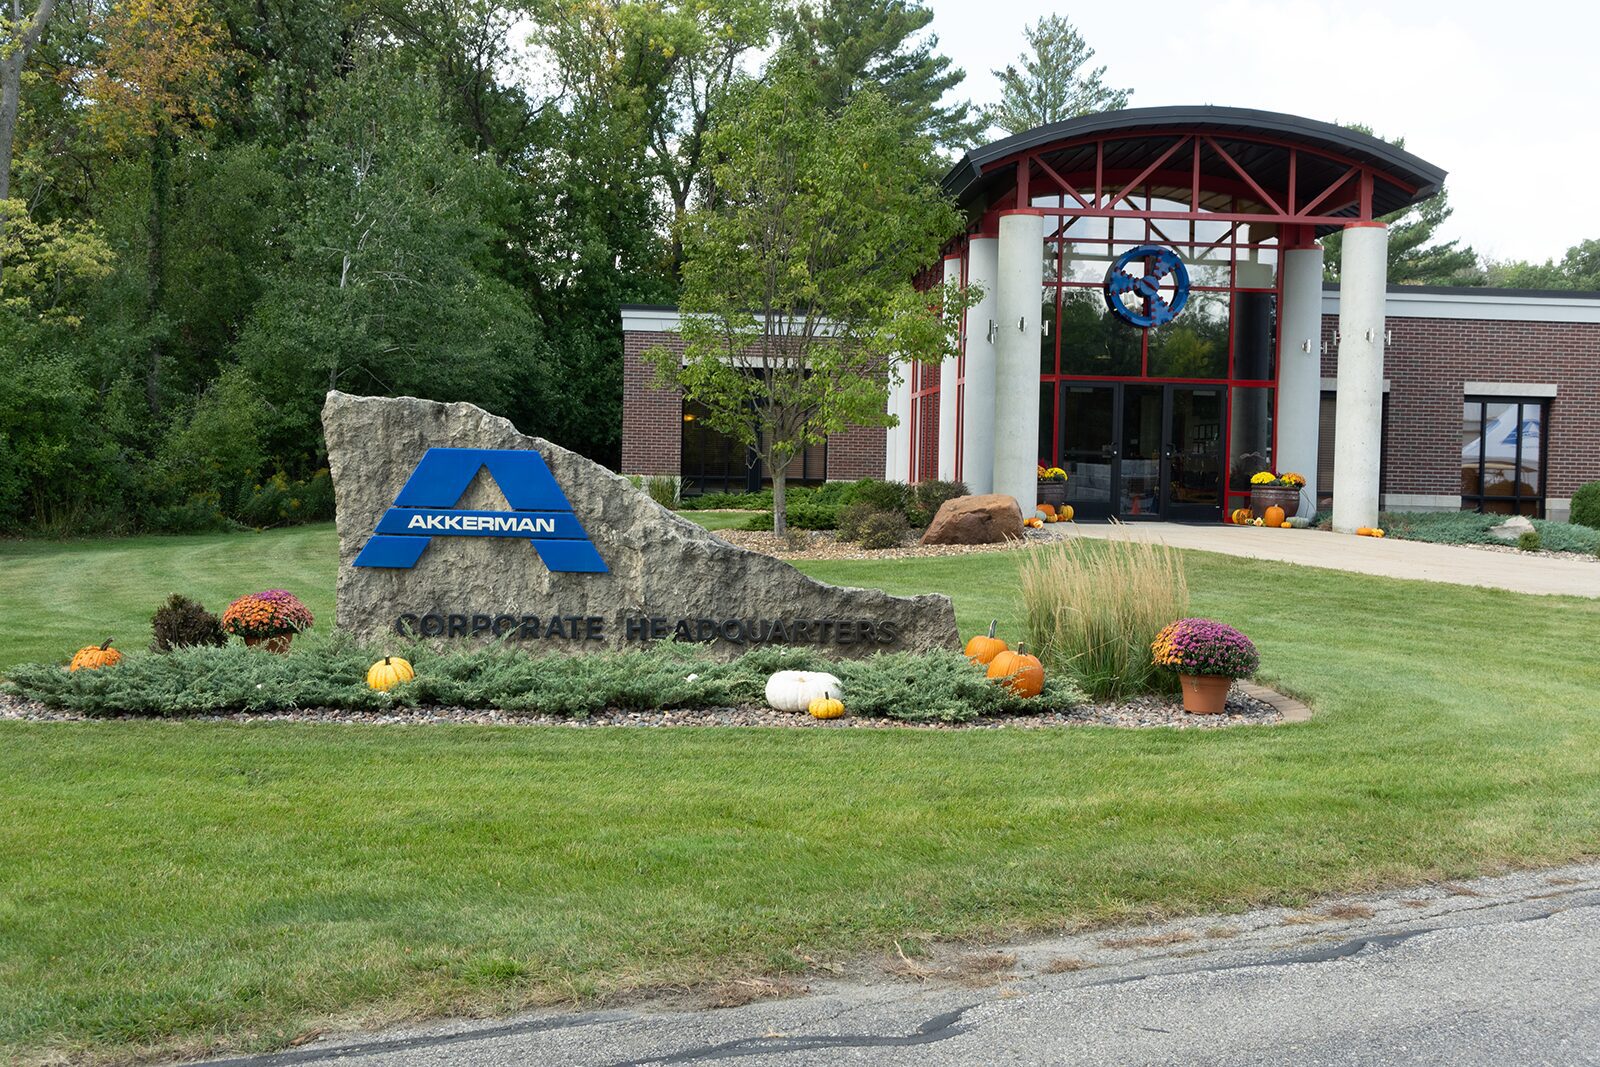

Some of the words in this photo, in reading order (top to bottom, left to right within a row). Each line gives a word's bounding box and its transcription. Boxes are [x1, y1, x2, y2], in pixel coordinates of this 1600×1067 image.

[407, 514, 555, 533] AKKERMAN
[396, 613, 604, 640] CORPORATE
[626, 617, 898, 645] HEADQUARTERS
